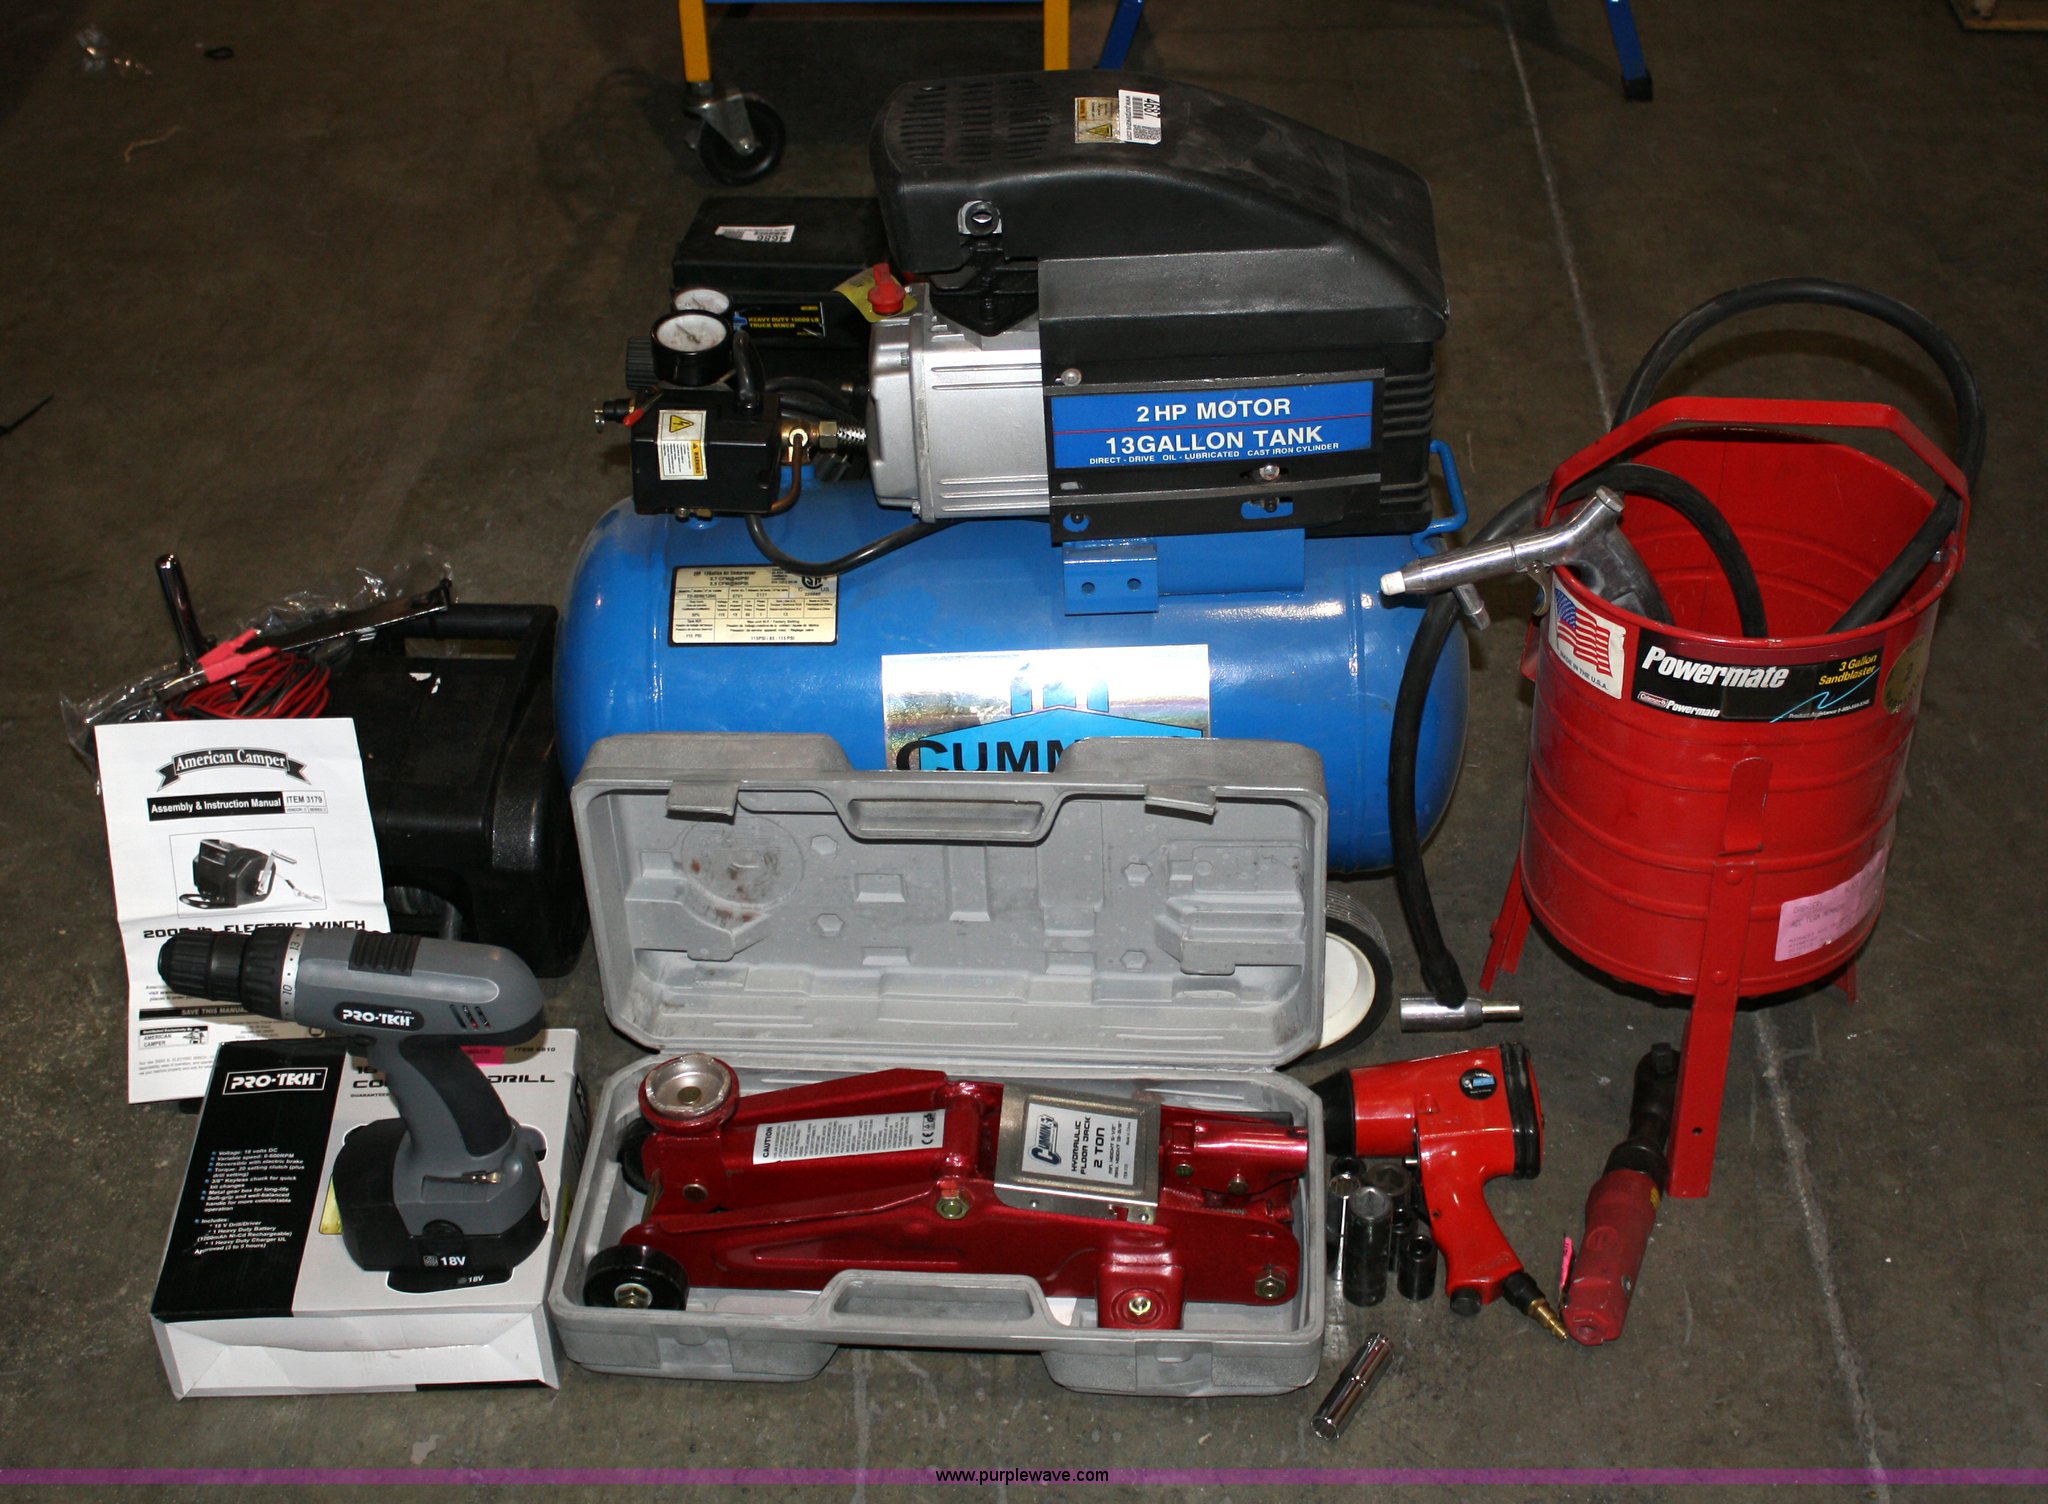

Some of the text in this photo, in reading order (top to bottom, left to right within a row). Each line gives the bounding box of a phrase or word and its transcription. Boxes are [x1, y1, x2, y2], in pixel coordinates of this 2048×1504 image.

[1144, 98, 1160, 119] 4687
[1196, 398, 1292, 420] MOTOR
[1253, 425, 1325, 447] TANK
[1089, 443, 1339, 466] DIRECT DRIVE OIL LUBRICATED CAST IRON CYLINDER
[1641, 646, 1790, 690] Powermate
[1839, 654, 1878, 672] 3 Gallon
[1578, 665, 1591, 681] THE
[1819, 664, 1877, 686] Sandblaster
[1666, 700, 1721, 718] Powermate
[176, 749, 287, 772] American Camper
[151, 798, 282, 814] Assembly & Instruction Manual
[286, 796, 303, 805] ITEM
[289, 941, 300, 951] 13
[282, 985, 293, 996] 10
[202, 1007, 218, 1015] THIS
[488, 1075, 556, 1084] DRILL
[763, 1126, 773, 1159] CAUTION
[1072, 1121, 1082, 1172] HYDRAULIC
[1080, 1117, 1091, 1176] FLOOR JACK
[1094, 1128, 1105, 1169] 2 TON
[440, 1256, 466, 1266] 18V
[468, 1275, 484, 1283] 18V
